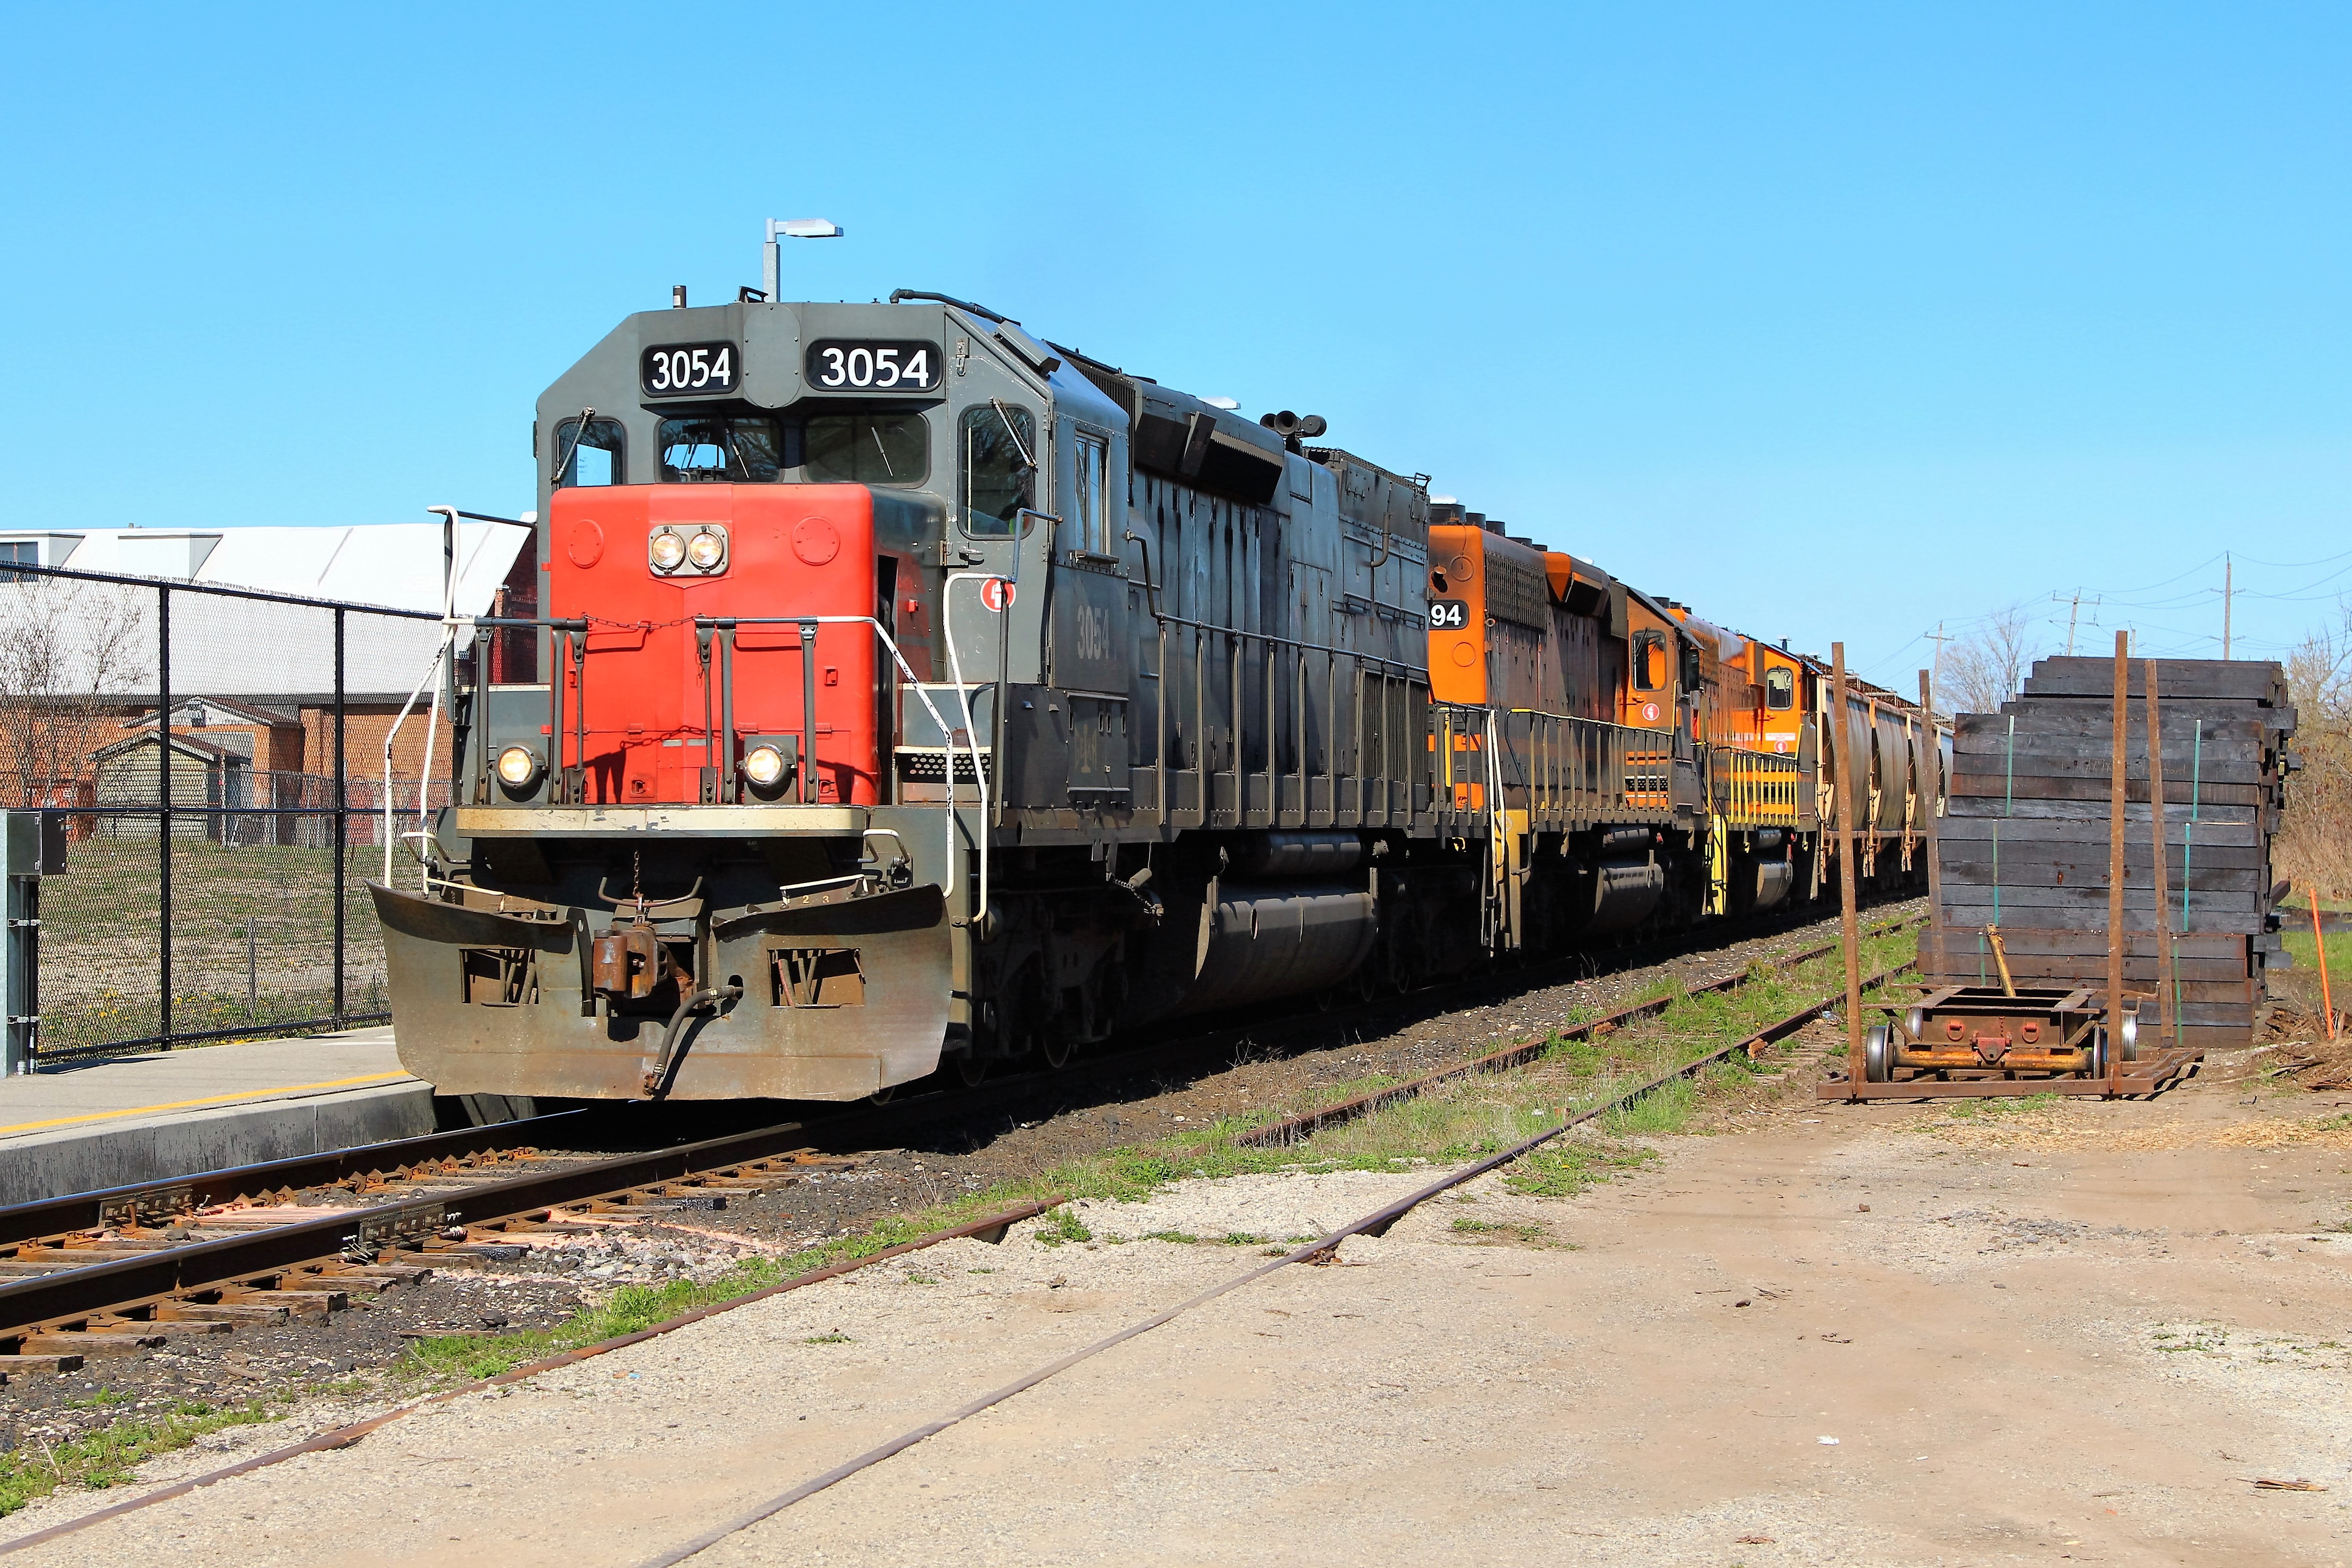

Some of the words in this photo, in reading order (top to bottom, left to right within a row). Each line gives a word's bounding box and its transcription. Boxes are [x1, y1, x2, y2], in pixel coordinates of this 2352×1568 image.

[652, 348, 731, 390] 3054
[821, 347, 929, 387] 3054
[1077, 605, 1110, 660] 3054
[1428, 604, 1462, 626] 94
[802, 895, 809, 904] 2
[822, 895, 829, 903] 3
